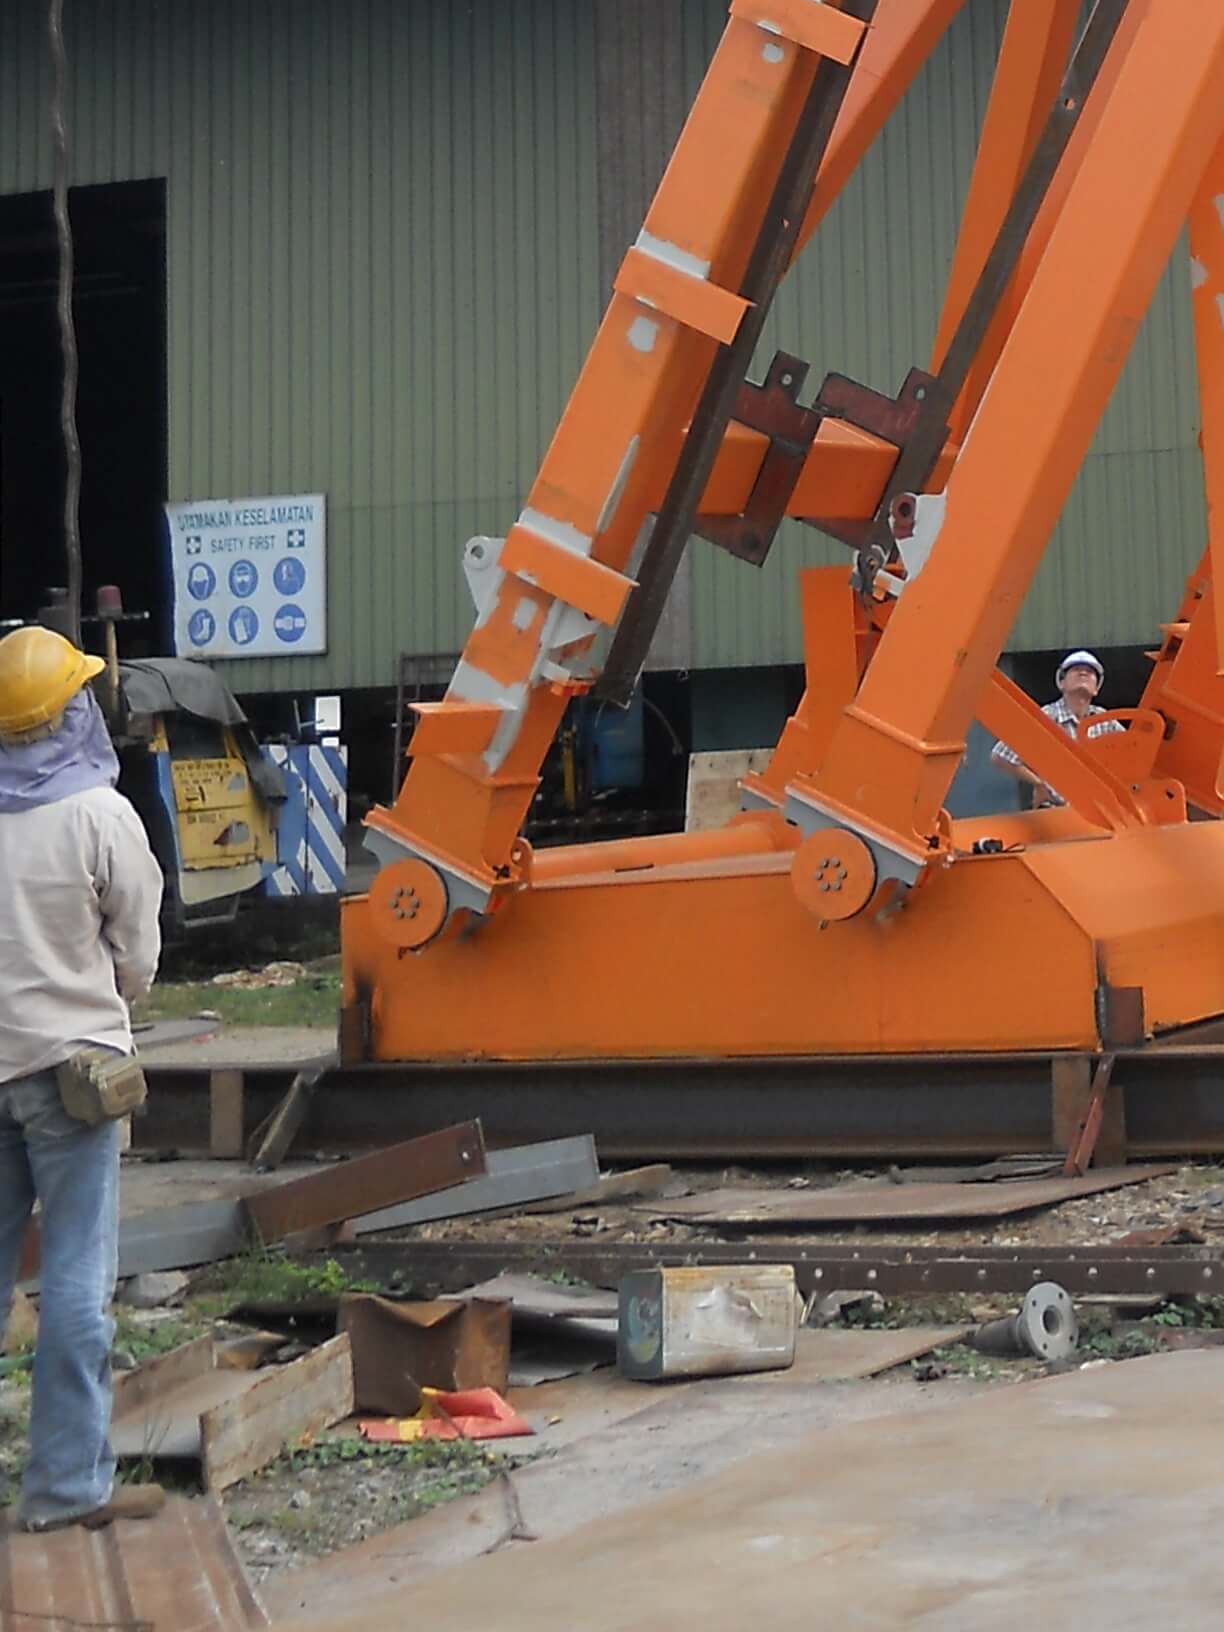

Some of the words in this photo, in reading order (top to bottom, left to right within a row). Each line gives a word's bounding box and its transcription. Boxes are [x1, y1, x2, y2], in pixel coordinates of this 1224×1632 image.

[235, 505, 313, 526] KESELAMATAN
[210, 537, 244, 553] SAFETY
[249, 535, 276, 550] FIRST
